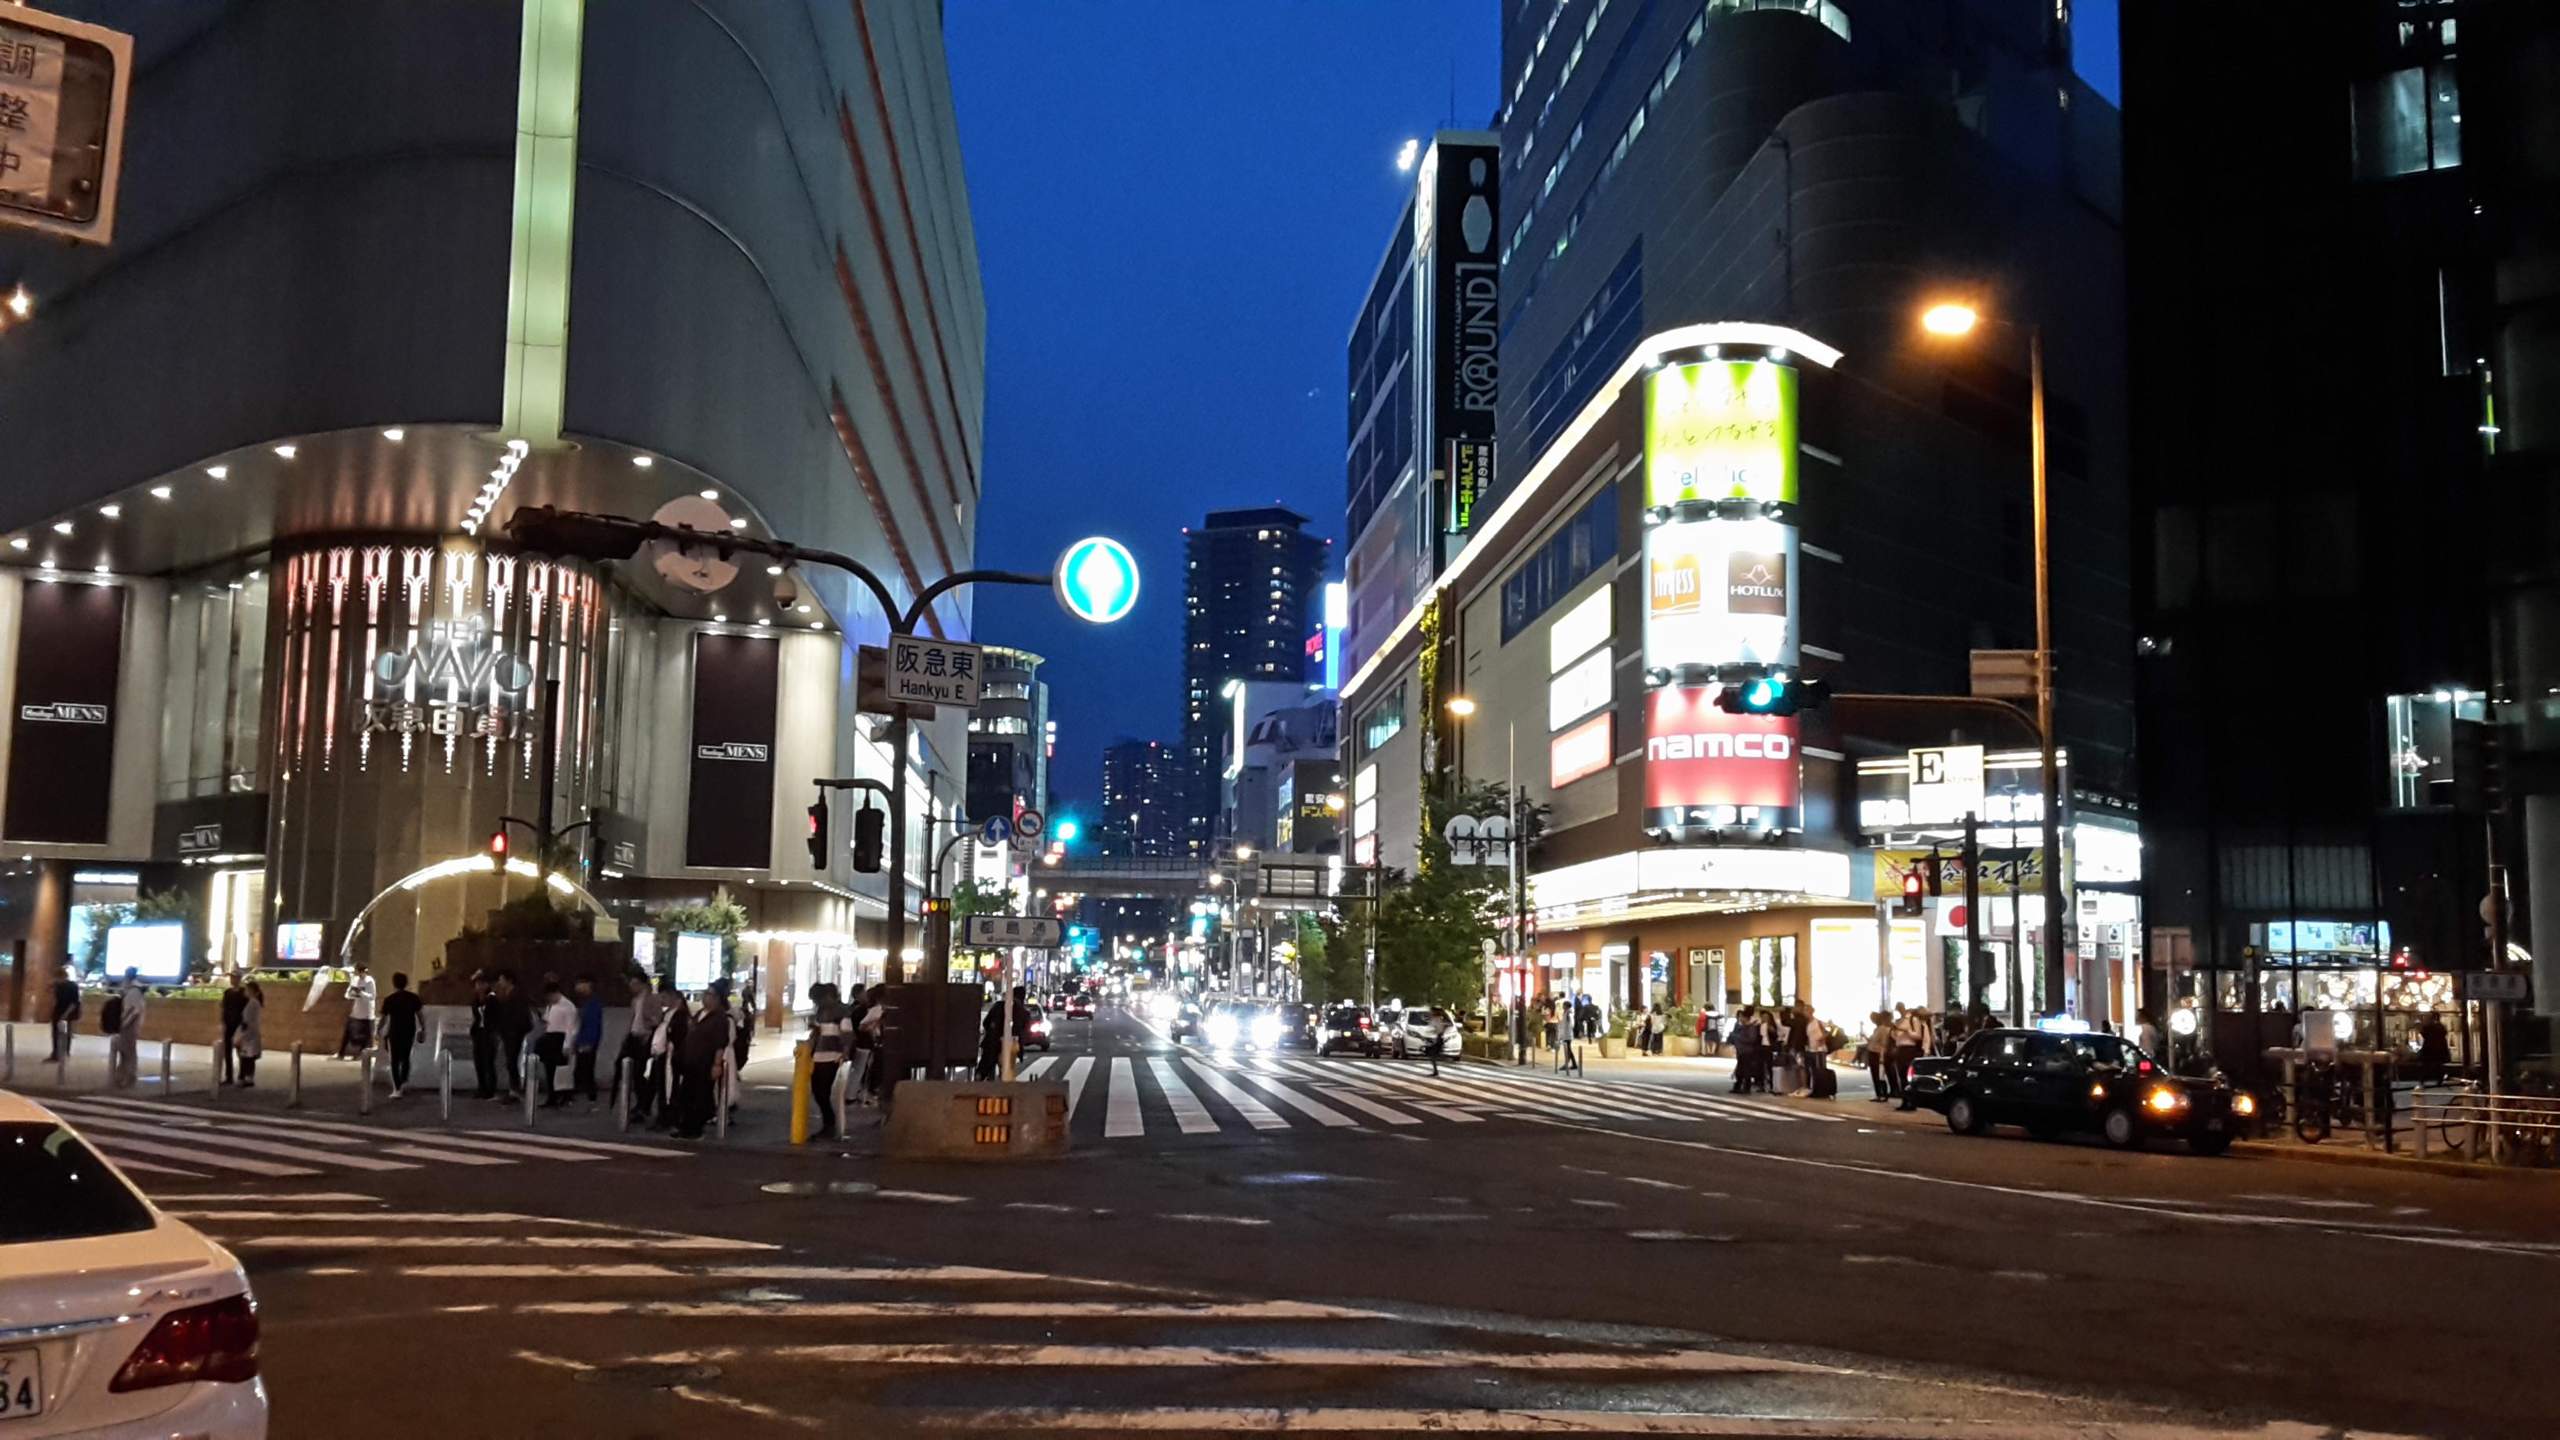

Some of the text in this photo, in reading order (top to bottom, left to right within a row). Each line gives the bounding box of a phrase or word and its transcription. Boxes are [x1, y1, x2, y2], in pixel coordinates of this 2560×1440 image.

[1731, 585, 1784, 598] HOTLUX
[896, 643, 974, 681] 阪急東
[900, 679, 949, 700] Hankyu
[1648, 733, 1790, 761] namco
[1912, 751, 1944, 785] E
